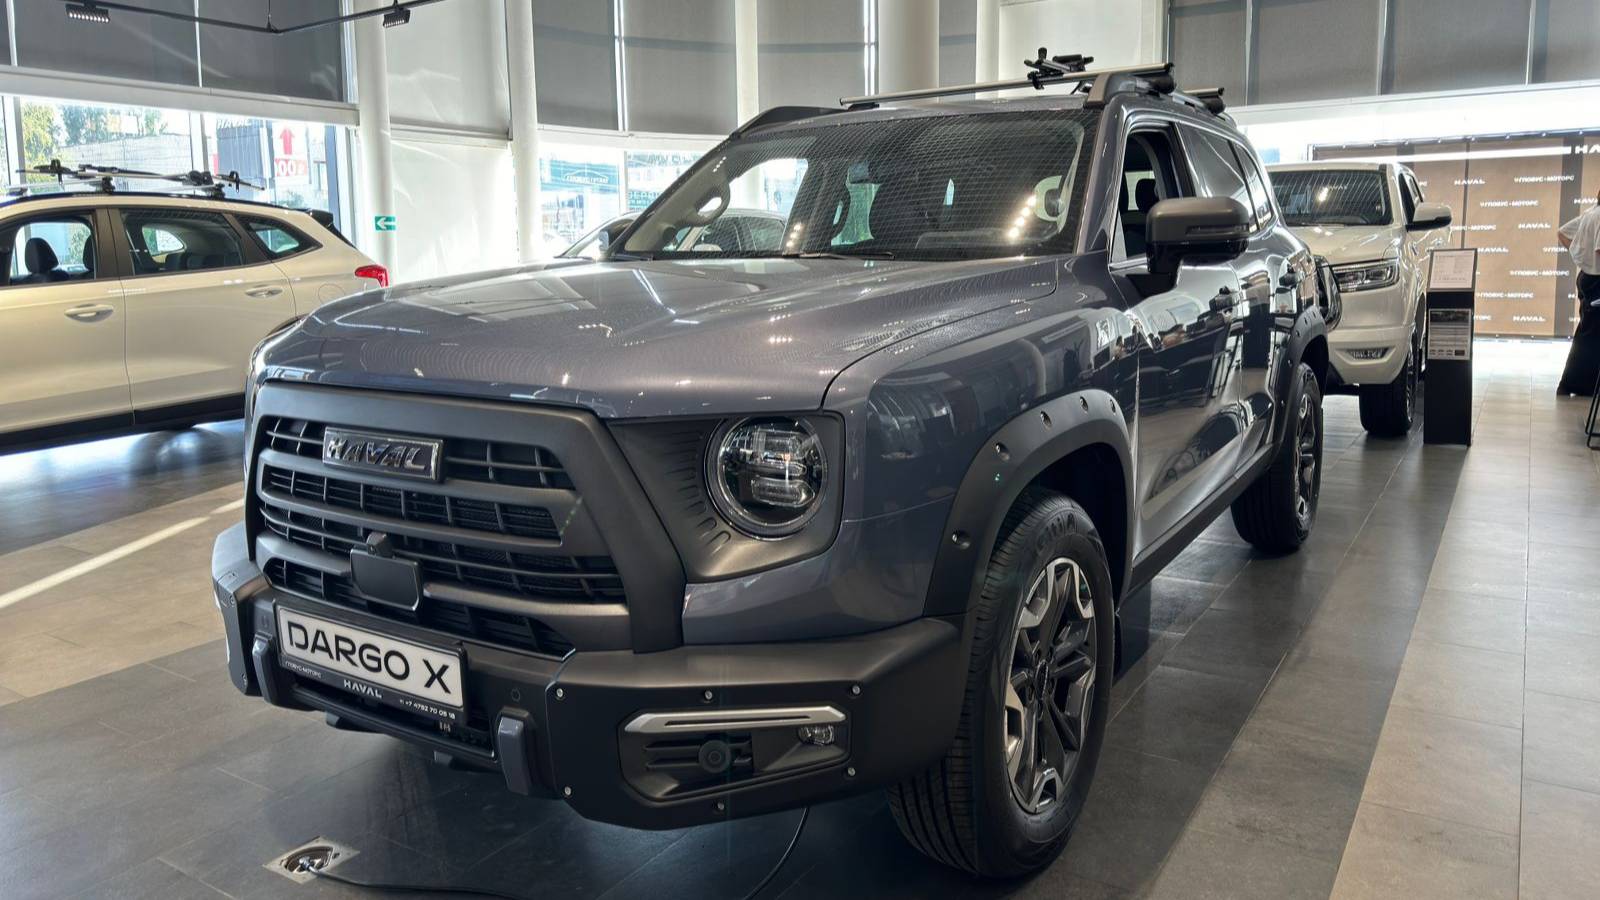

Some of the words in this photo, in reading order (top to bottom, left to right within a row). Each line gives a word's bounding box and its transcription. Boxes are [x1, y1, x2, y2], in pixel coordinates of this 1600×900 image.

[327, 438, 425, 470] HAVAL
[287, 620, 410, 681] DARGO
[422, 658, 452, 695] X
[343, 679, 383, 699] HAVAL
